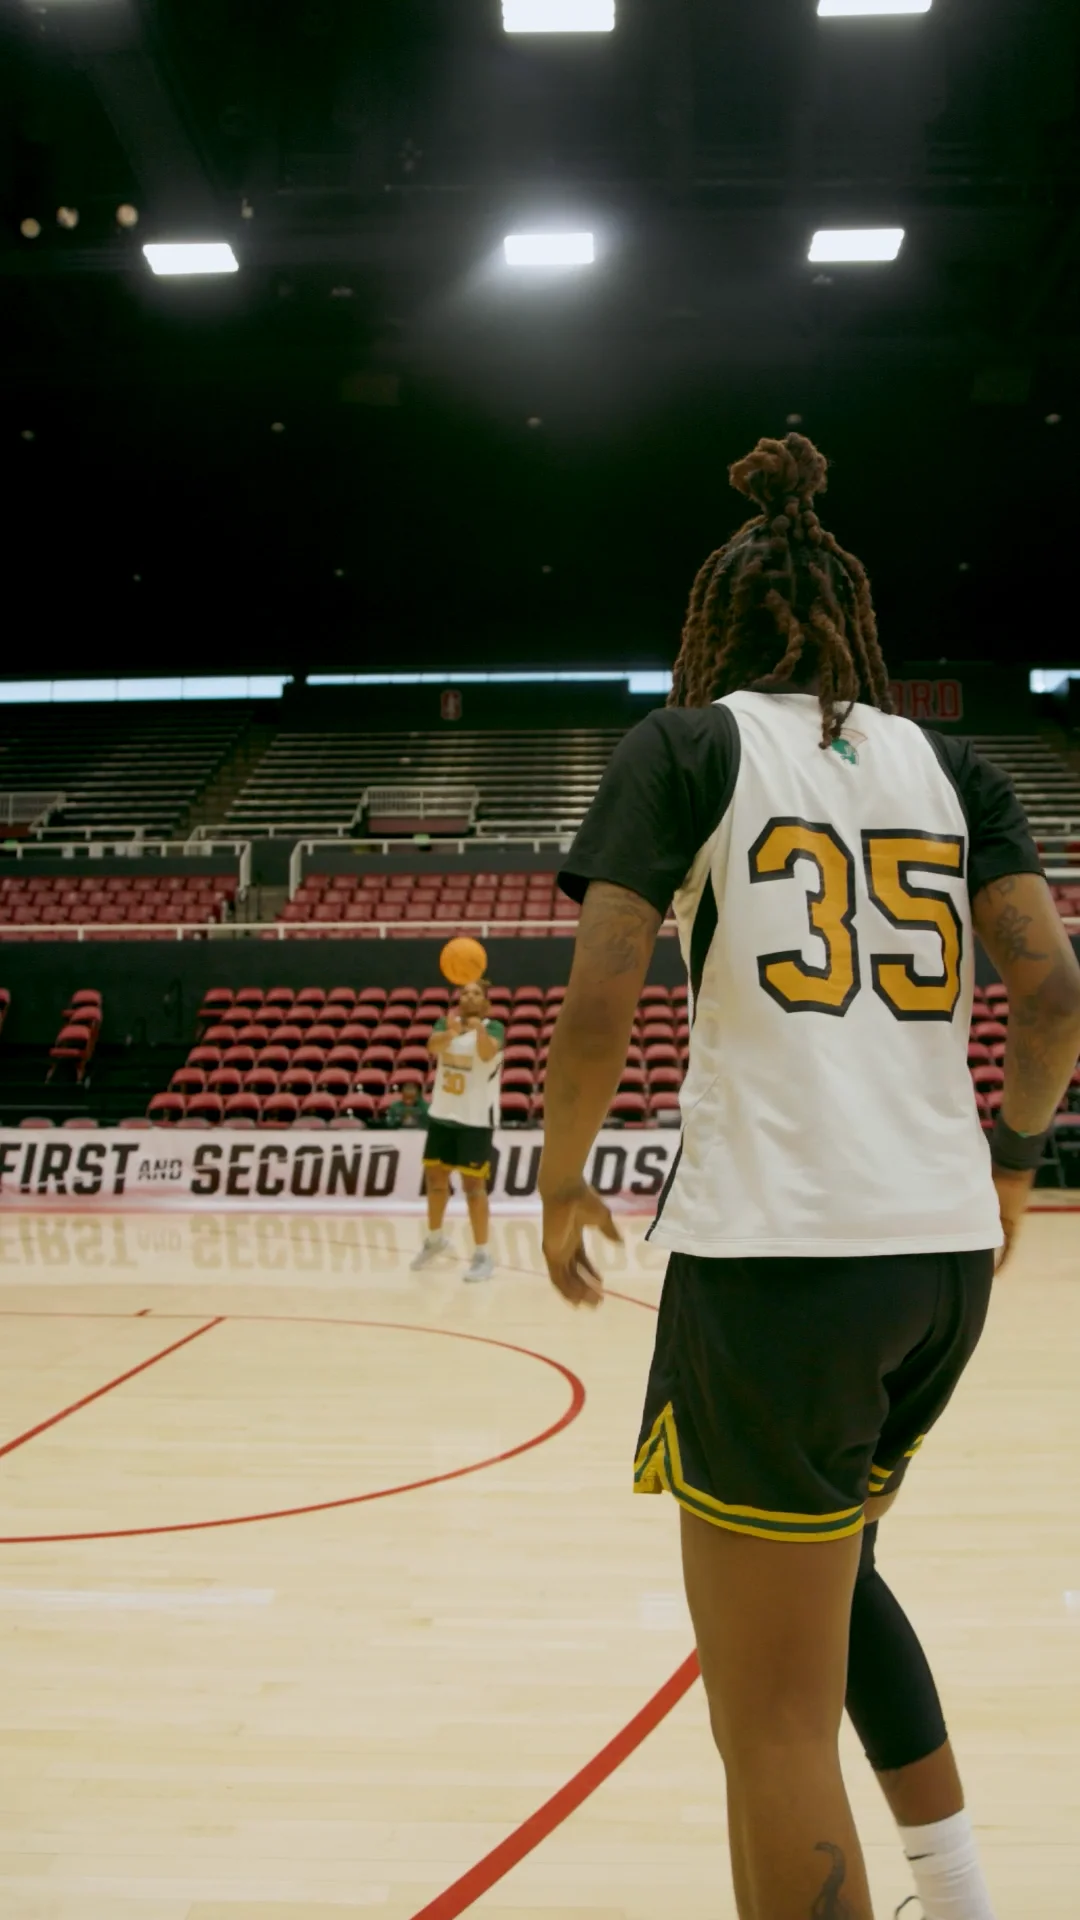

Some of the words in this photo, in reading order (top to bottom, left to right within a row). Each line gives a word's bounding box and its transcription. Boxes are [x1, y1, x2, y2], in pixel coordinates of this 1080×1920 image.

[747, 816, 965, 1023] 35
[0, 1143, 139, 1196] FIRST
[138, 1159, 183, 1181] AND
[190, 1144, 400, 1197] SECOND
